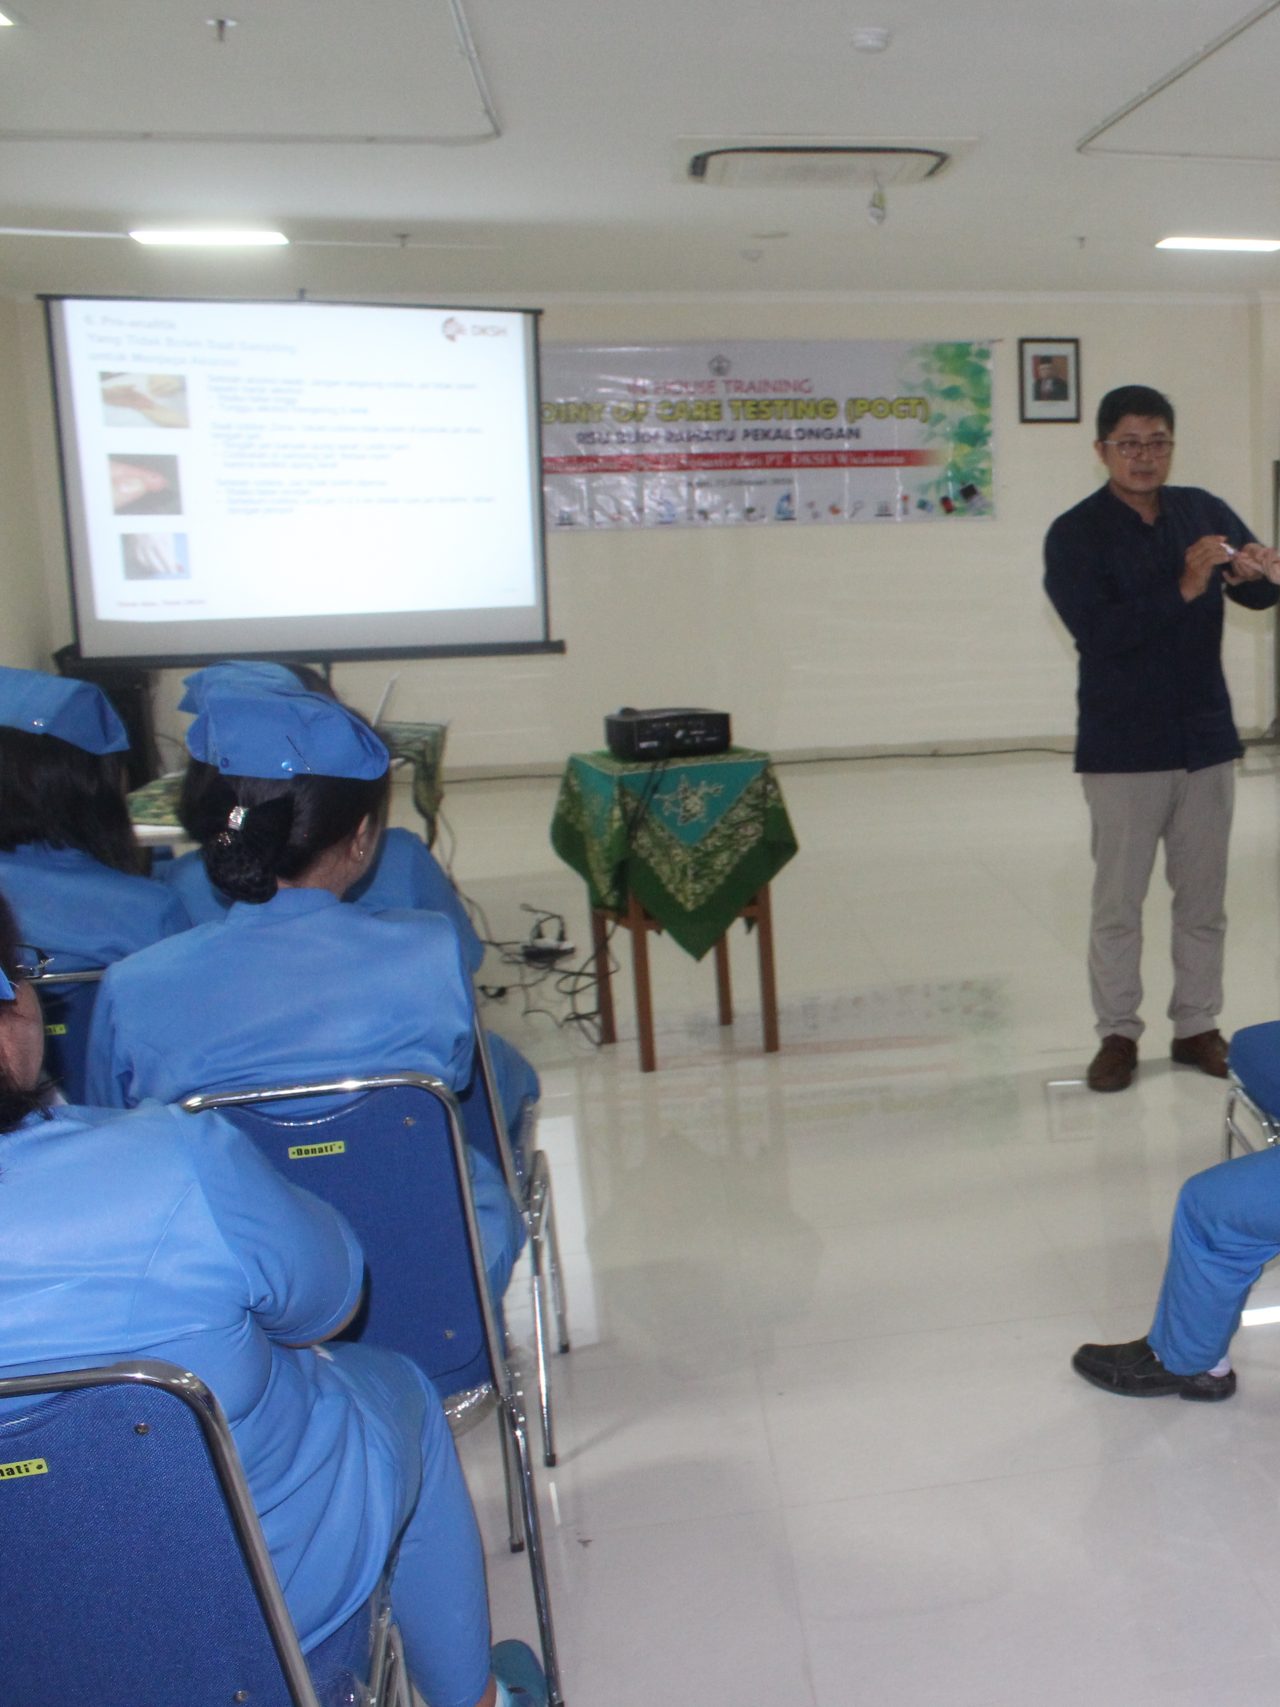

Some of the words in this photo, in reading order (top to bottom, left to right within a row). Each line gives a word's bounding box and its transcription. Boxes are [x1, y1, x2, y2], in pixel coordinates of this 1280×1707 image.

[653, 379, 716, 395] HOUSE
[723, 378, 813, 395] TRAINING
[610, 400, 650, 423] OF
[655, 399, 722, 422] CARE
[728, 398, 838, 421] TESTING
[845, 396, 930, 424] (POCT)
[741, 426, 861, 442] PEKALONGAN
[296, 1144, 335, 1157] Donati
